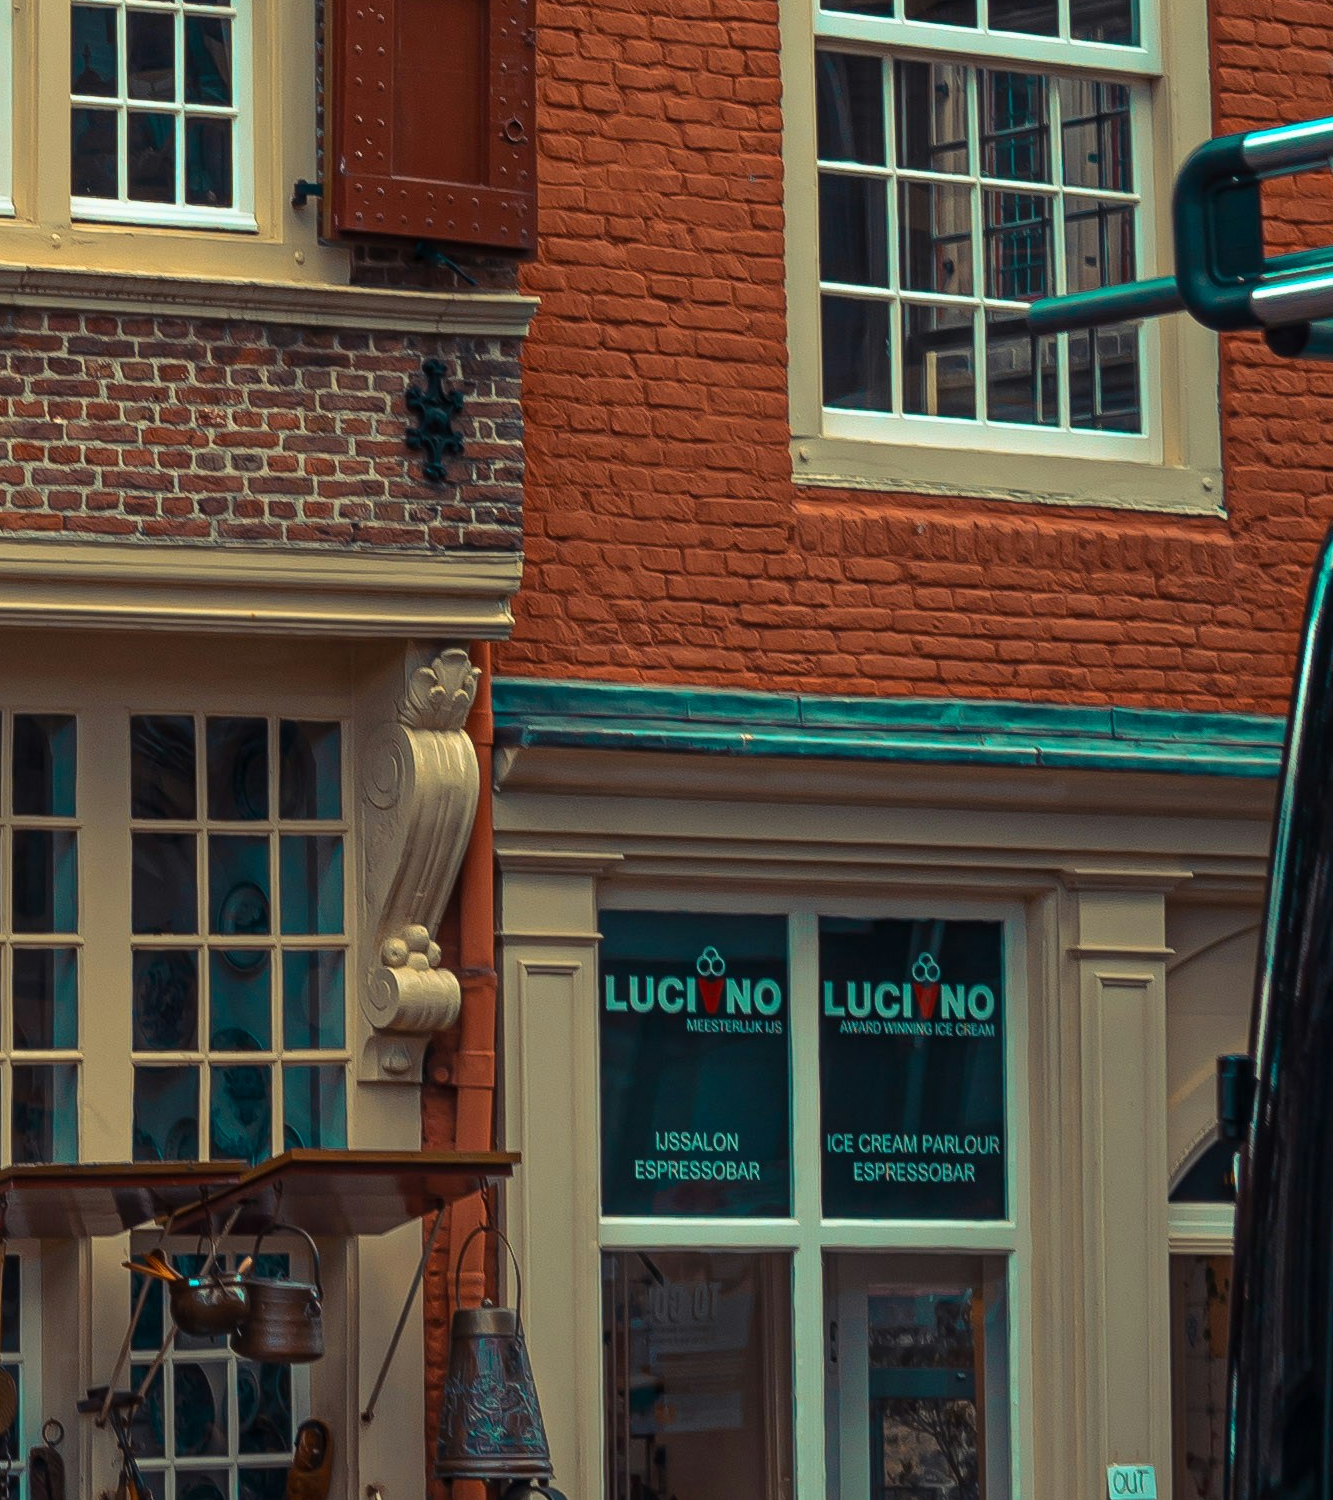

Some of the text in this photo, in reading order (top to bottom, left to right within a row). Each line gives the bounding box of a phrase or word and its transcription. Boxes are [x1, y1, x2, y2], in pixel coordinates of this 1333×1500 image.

[685, 1017, 784, 1035] MEESTERLIJK IJS
[839, 1019, 996, 1037] AWARD WINNING ICE CREAM
[654, 1130, 740, 1152] IJSSALON
[826, 1133, 1002, 1155] ICE CREAM PARLOUR
[634, 1158, 762, 1182] ESPRESSOBAR
[852, 1161, 977, 1184] ESPRESSOBAR
[1113, 1469, 1149, 1495] OUT
